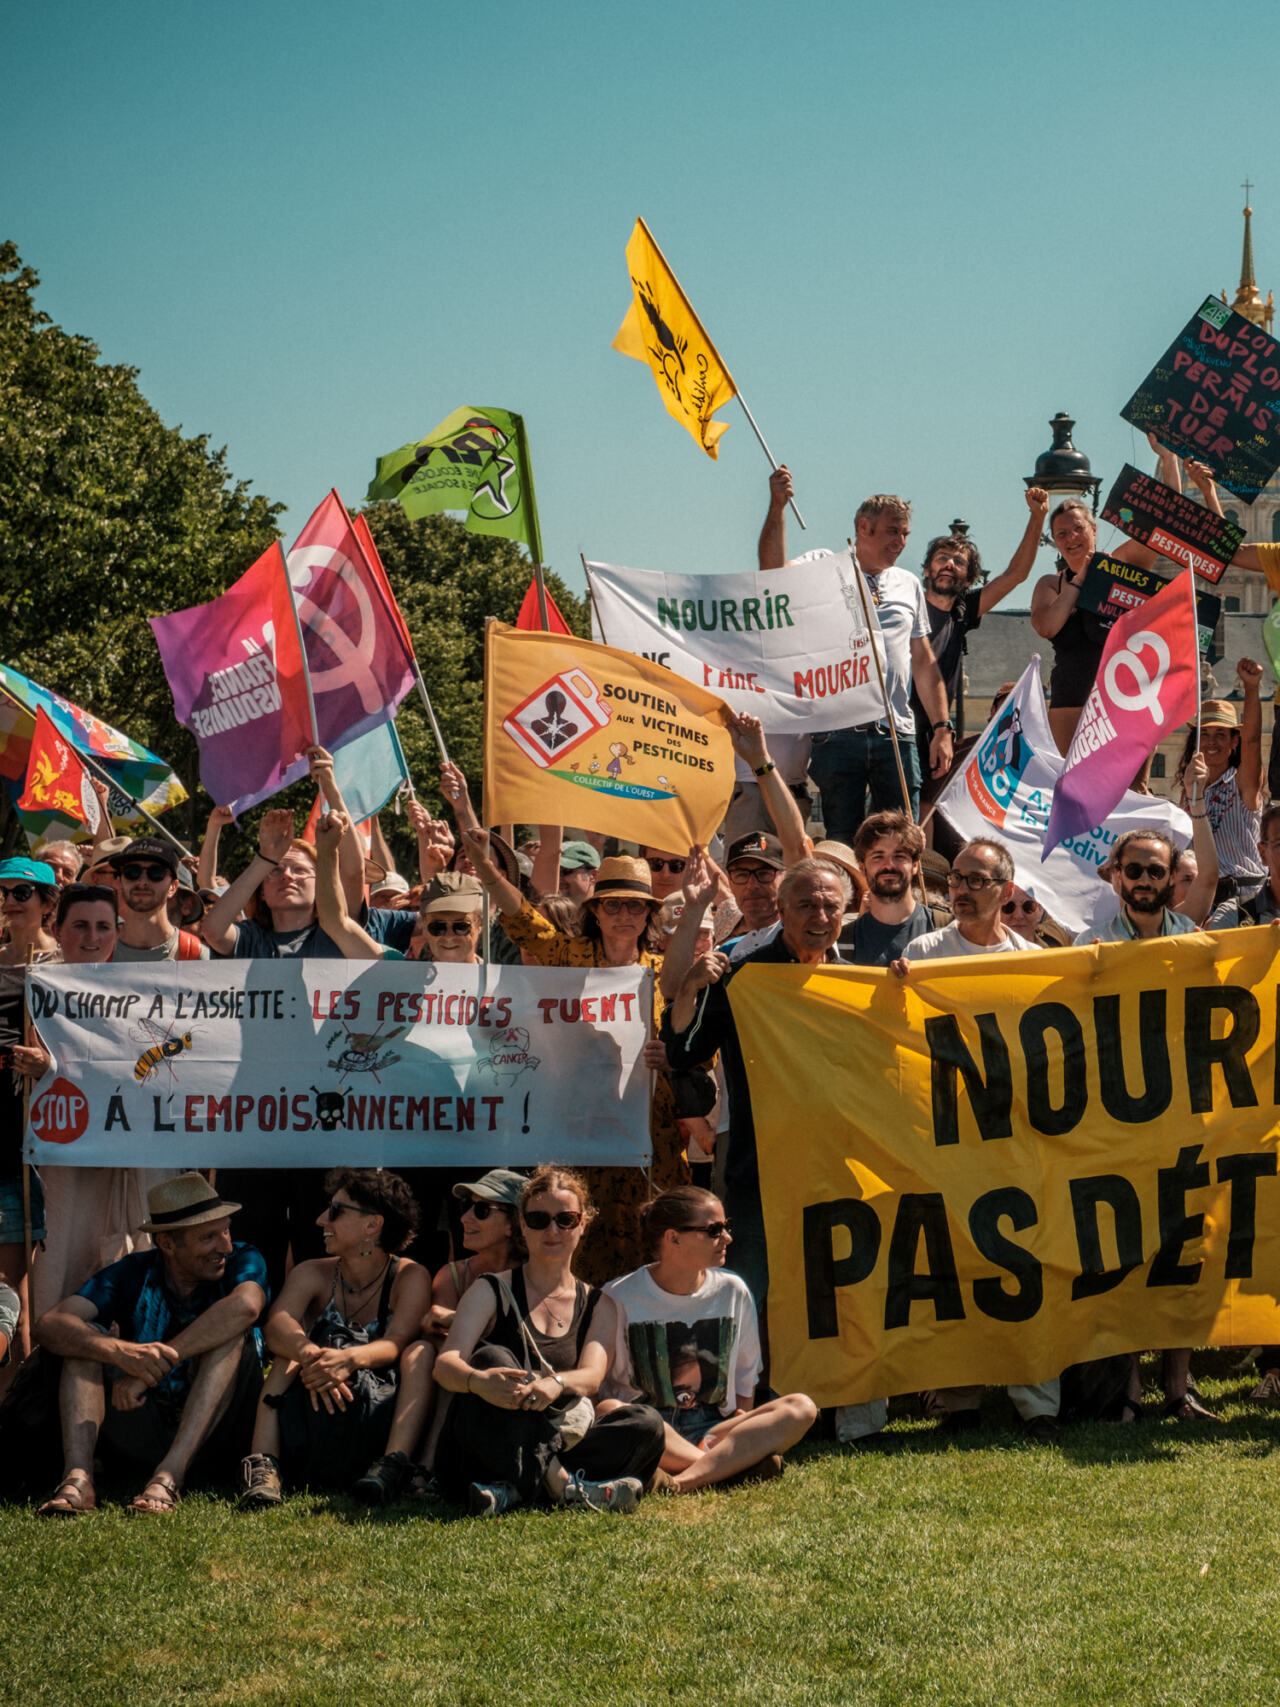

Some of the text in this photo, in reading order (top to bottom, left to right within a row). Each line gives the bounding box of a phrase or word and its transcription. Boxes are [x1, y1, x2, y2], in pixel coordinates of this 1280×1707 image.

[1236, 324, 1277, 358] LOI
[1173, 351, 1273, 432] PERMIS
[1190, 392, 1229, 428] DE
[1166, 398, 1235, 460] TUER
[1096, 558, 1150, 587] ABEILLES
[656, 588, 795, 632] NOURRIR
[793, 652, 870, 699] MOURIR
[603, 683, 677, 717] SOUTIEN
[616, 714, 709, 746] AUX VICTIMES
[666, 738, 682, 748] DES
[632, 740, 715, 773] PESTICIDES
[573, 774, 655, 799] COLLECTIF DE L'OUEST
[30, 983, 59, 1020] DU
[65, 990, 141, 1020] CHAMP
[147, 986, 167, 1020] À
[312, 989, 361, 1021] LES
[376, 989, 512, 1028] PESTICIDES
[537, 993, 636, 1024] TUENT
[492, 1053, 528, 1065] CANCER
[32, 1093, 86, 1131] STOP
[803, 1186, 1044, 1340] PAS
